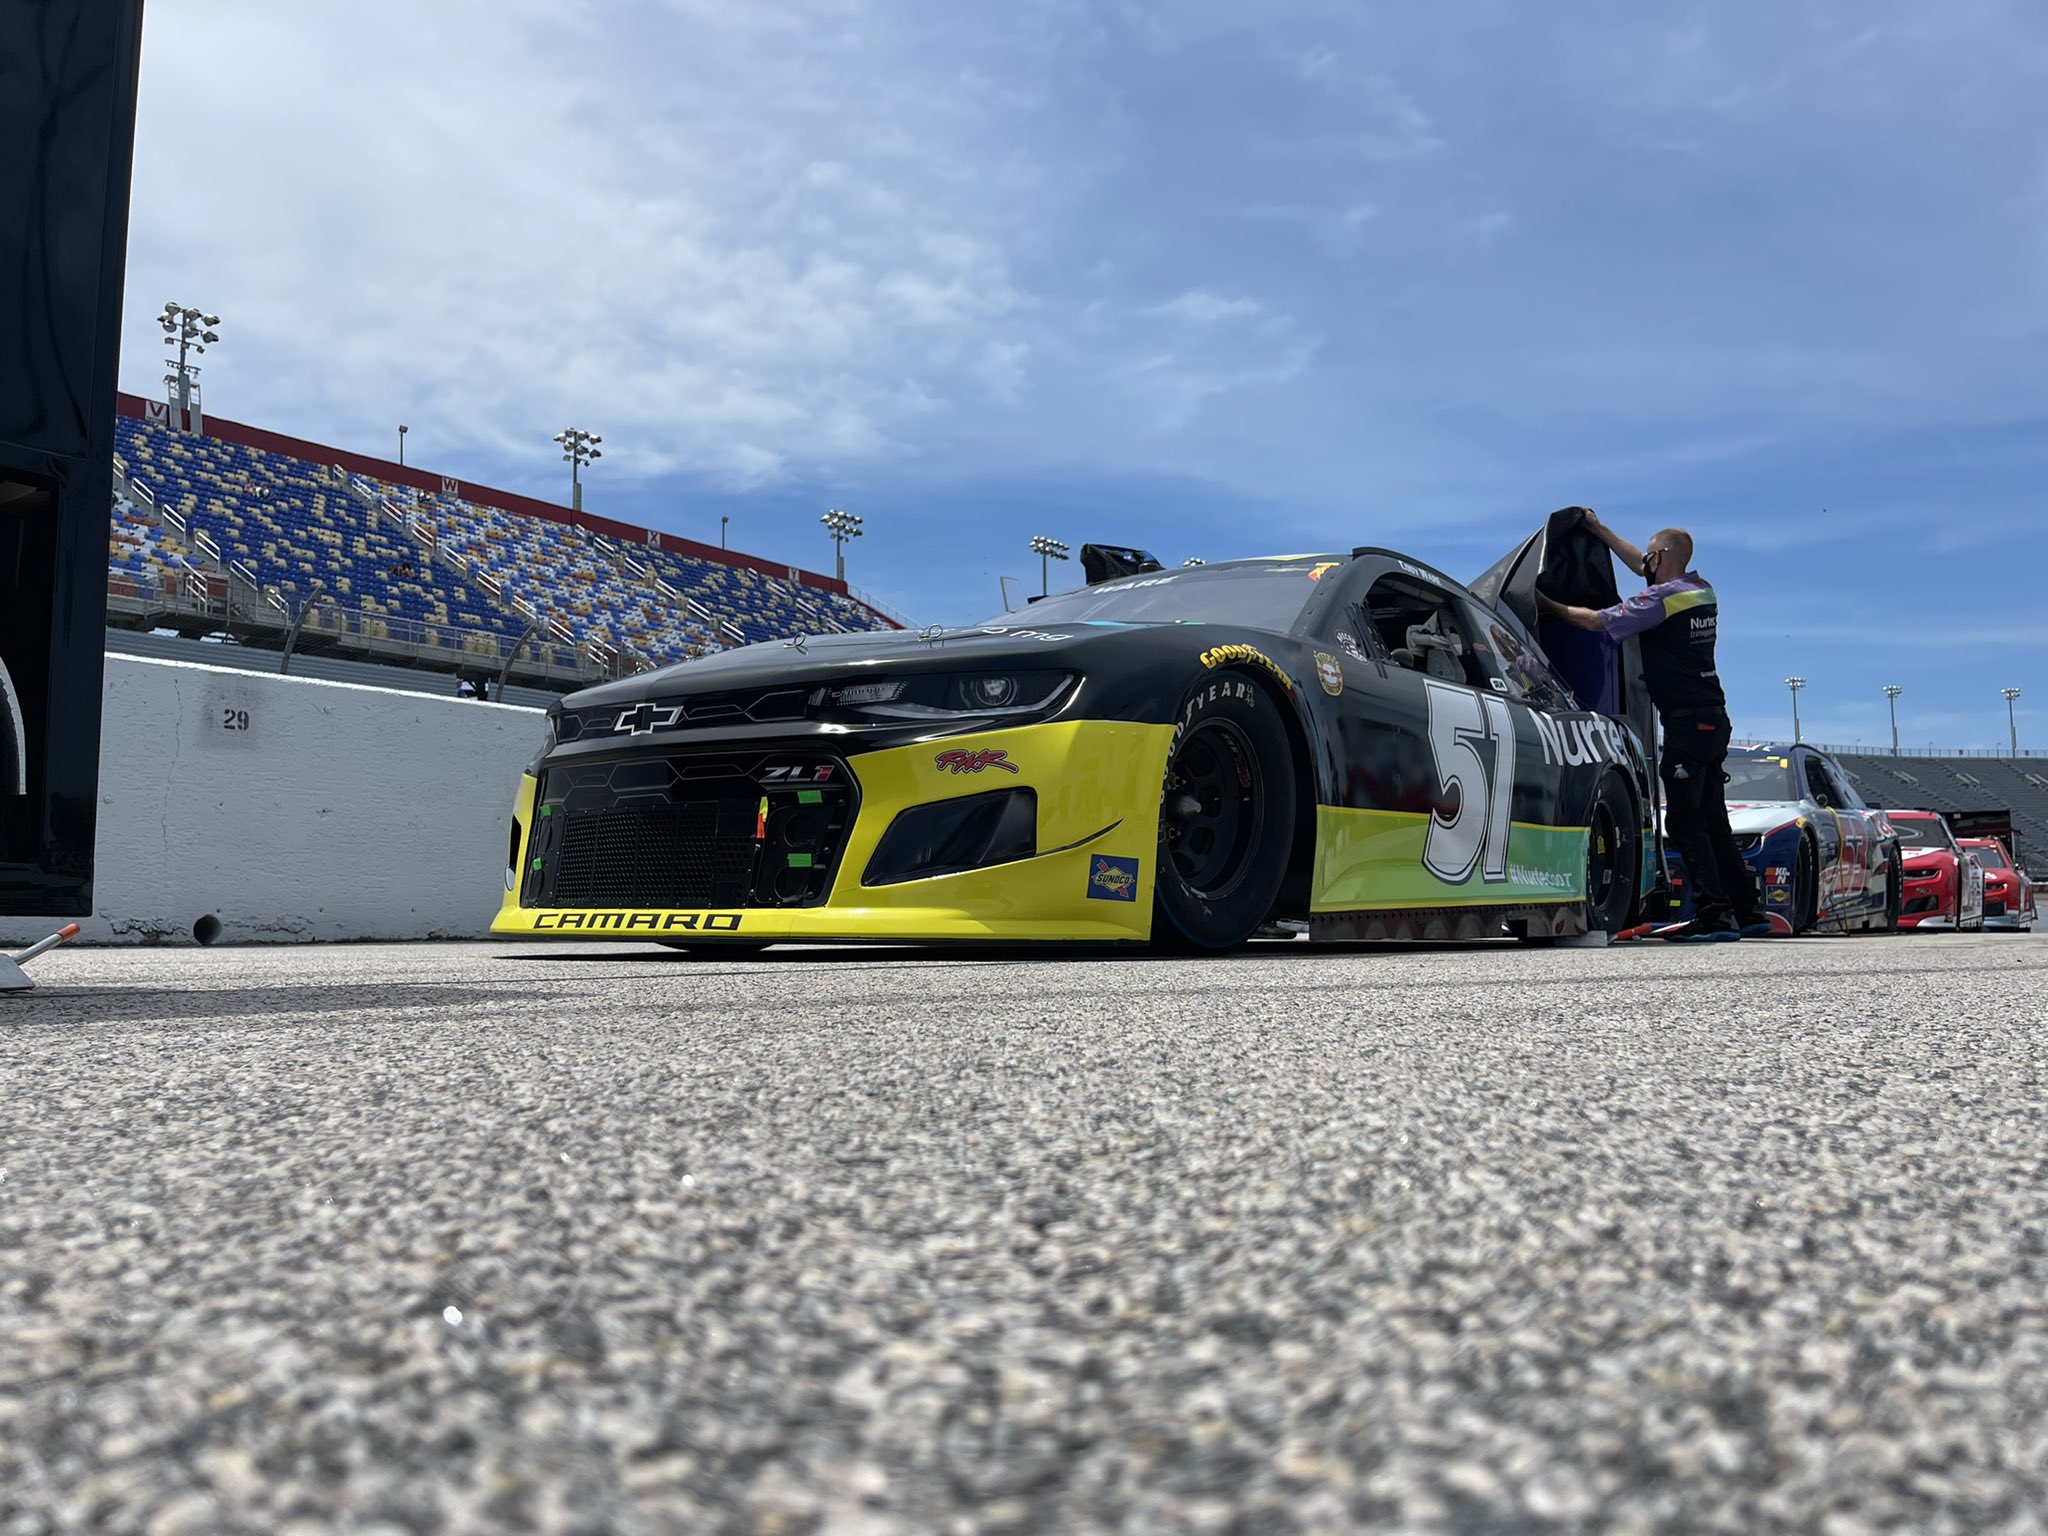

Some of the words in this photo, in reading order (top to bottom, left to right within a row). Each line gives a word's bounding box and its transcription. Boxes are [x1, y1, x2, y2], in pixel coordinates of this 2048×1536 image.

[149, 402, 164, 417] V
[443, 479, 457, 492] W
[1009, 629, 1075, 642] mg
[1199, 643, 1293, 691] GOODYEAR
[223, 708, 250, 731] 29
[758, 764, 835, 784] ZL1
[1422, 678, 1517, 885] 51
[1096, 873, 1130, 885] SUNOCO
[532, 912, 744, 932] CAMARO
